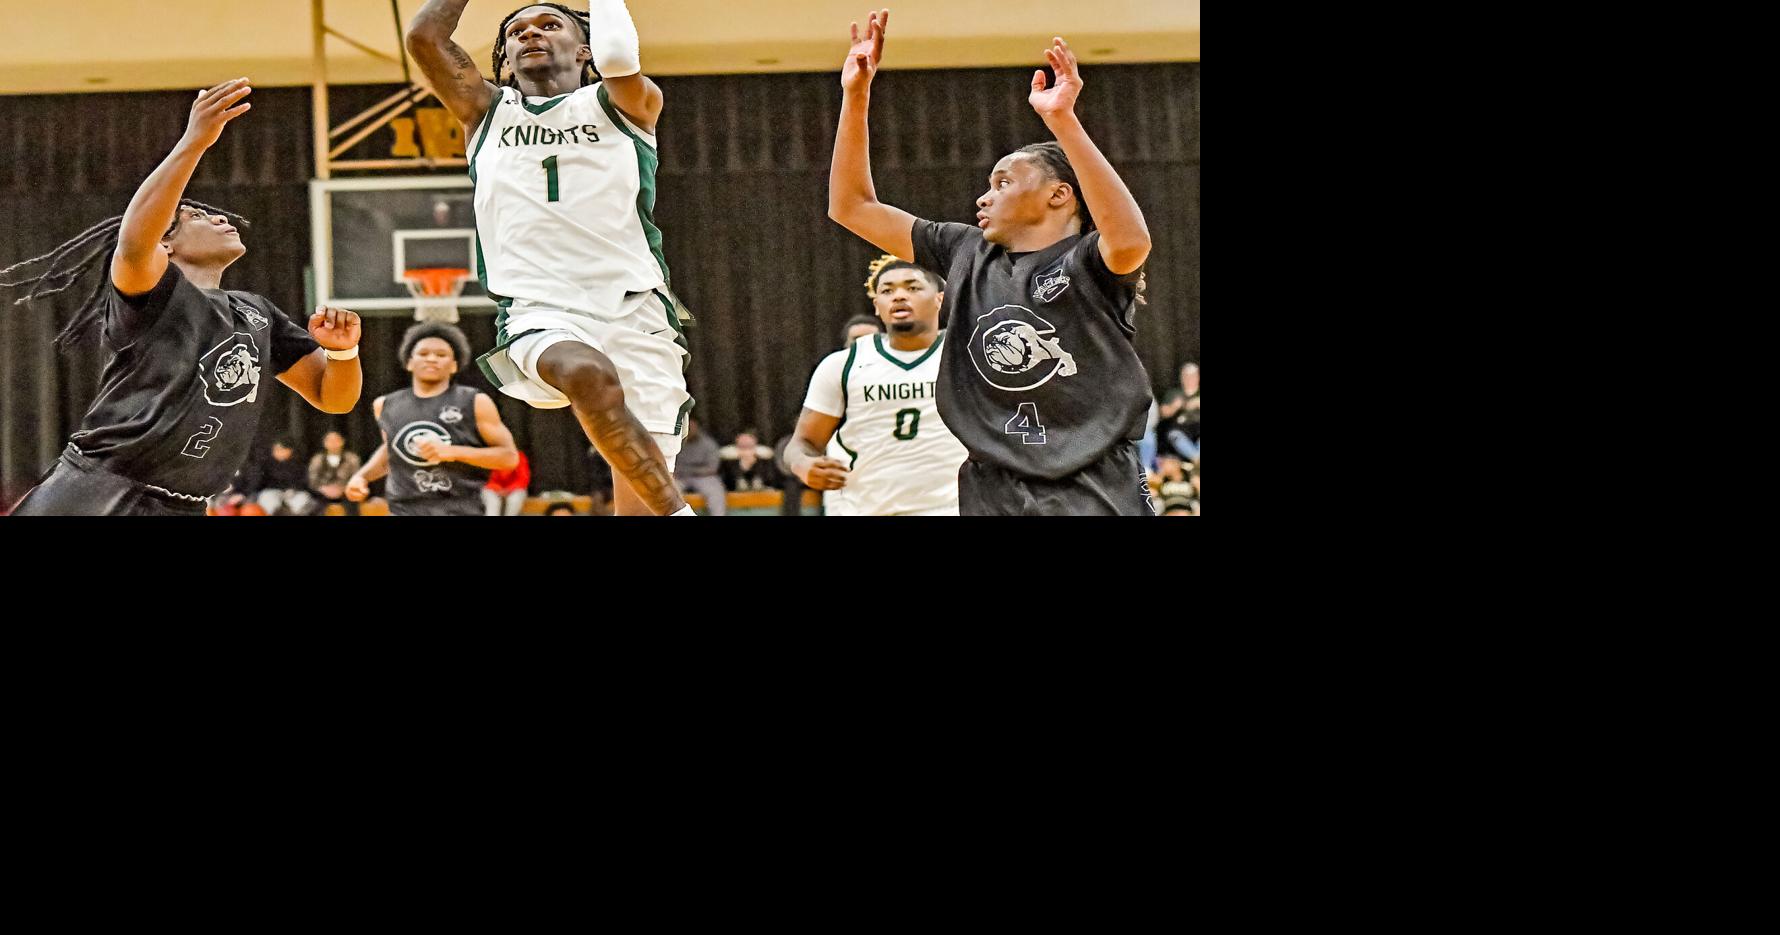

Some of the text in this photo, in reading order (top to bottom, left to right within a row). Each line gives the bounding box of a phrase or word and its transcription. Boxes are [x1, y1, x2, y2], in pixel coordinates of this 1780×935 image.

[498, 124, 600, 148] KNIGHTS
[541, 154, 560, 203] 1
[181, 415, 224, 459] 2
[893, 407, 921, 441] 0
[1004, 402, 1047, 445] 4
